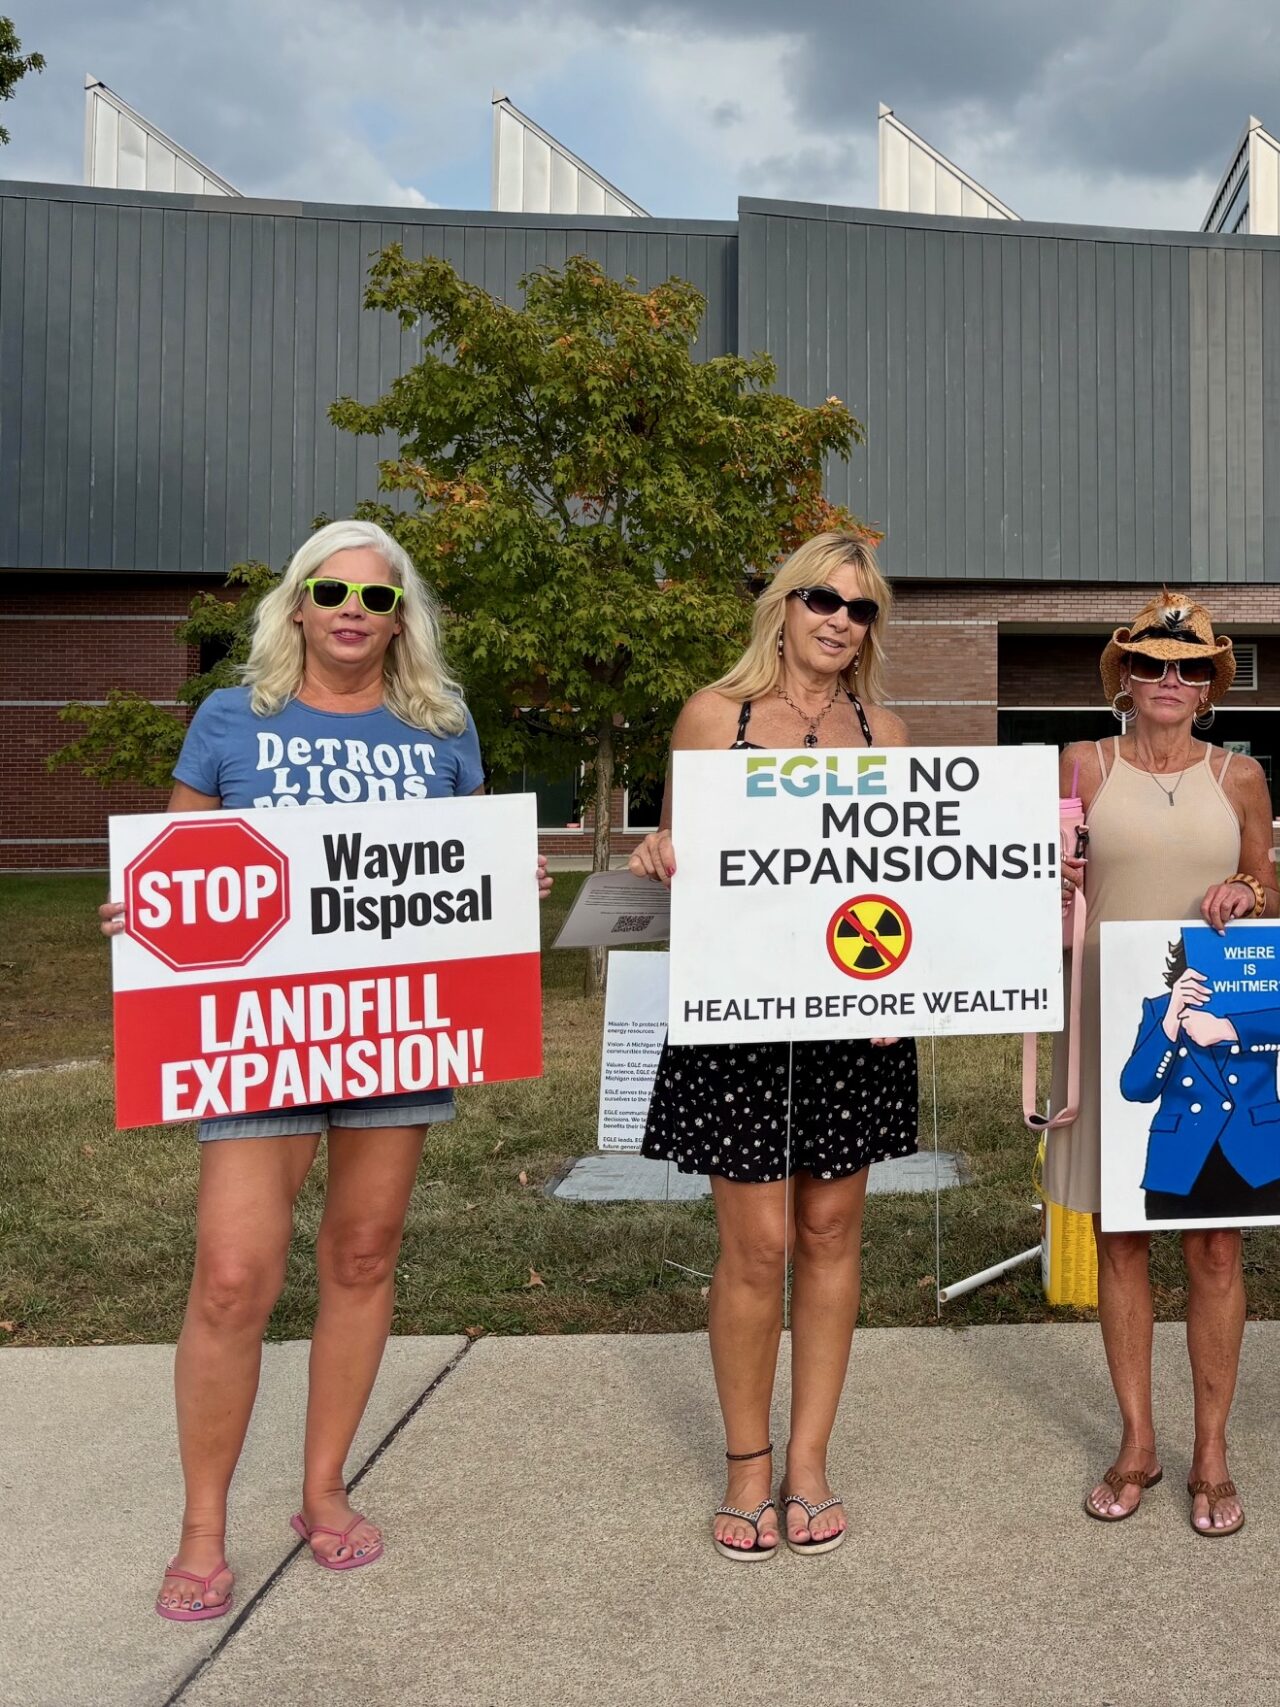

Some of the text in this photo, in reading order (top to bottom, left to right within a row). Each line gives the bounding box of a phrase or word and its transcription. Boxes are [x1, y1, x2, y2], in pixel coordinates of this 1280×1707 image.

[746, 755, 980, 797] EGLE NO
[822, 801, 961, 839] MORE
[323, 832, 466, 886] Wayne
[720, 843, 1056, 887] EXPANSIONS!!
[138, 864, 278, 929] STOP
[310, 875, 492, 939] Disposal
[1224, 946, 1275, 959] WHERE
[1243, 964, 1256, 976] IS
[200, 973, 451, 1054] LANDFILL
[684, 988, 1048, 1022] HEALTH BEFORE WEALTH!
[161, 1028, 485, 1121] EXPANSION!
